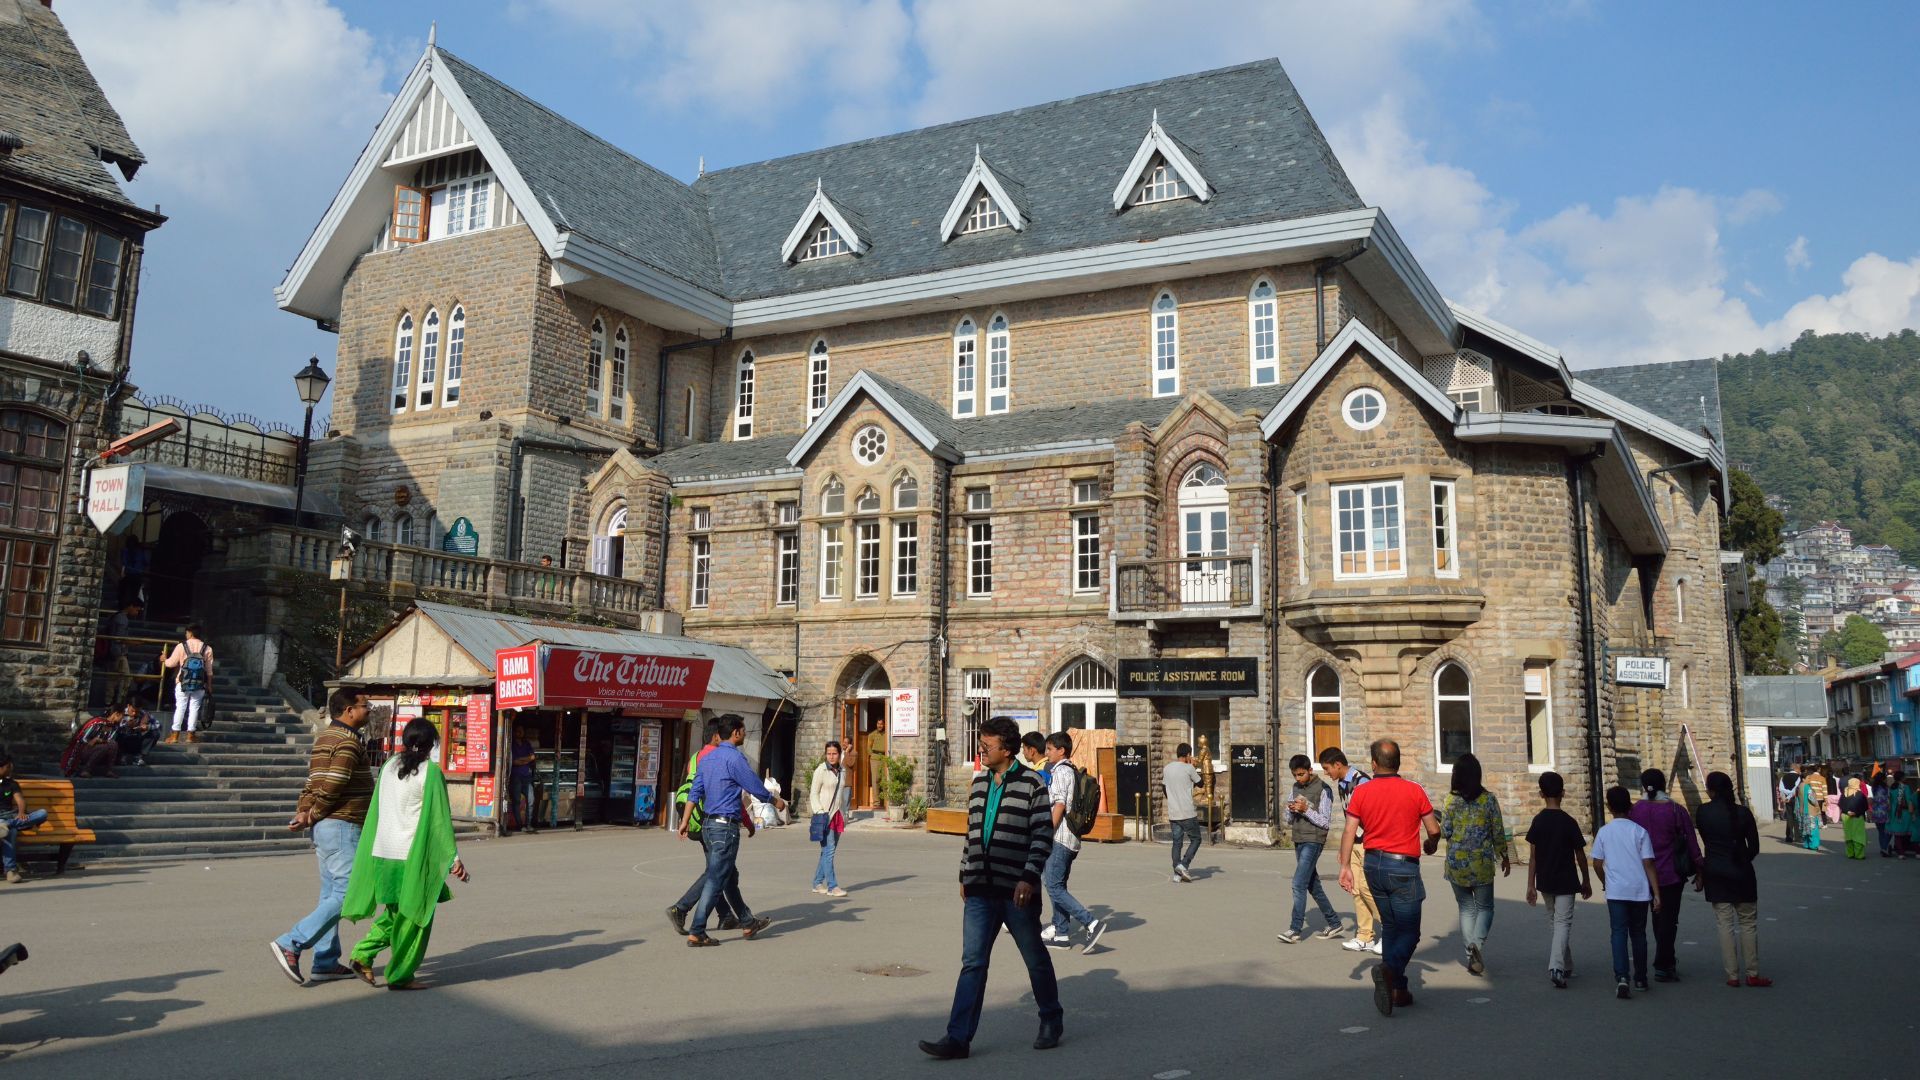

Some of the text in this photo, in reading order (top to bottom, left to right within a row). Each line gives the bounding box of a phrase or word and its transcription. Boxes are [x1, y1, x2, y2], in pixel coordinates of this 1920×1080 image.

[96, 478, 124, 493] TOWN
[92, 498, 120, 512] HALL
[503, 656, 529, 676] RAMA
[574, 651, 690, 687] The Tribune
[1625, 661, 1656, 669] POLICE
[1130, 671, 1246, 682] POLICE ASSISTANCE ROOM
[1619, 671, 1662, 680] ASSISTANCE
[500, 678, 533, 699] BAKERS
[598, 687, 658, 698] Voice of the People
